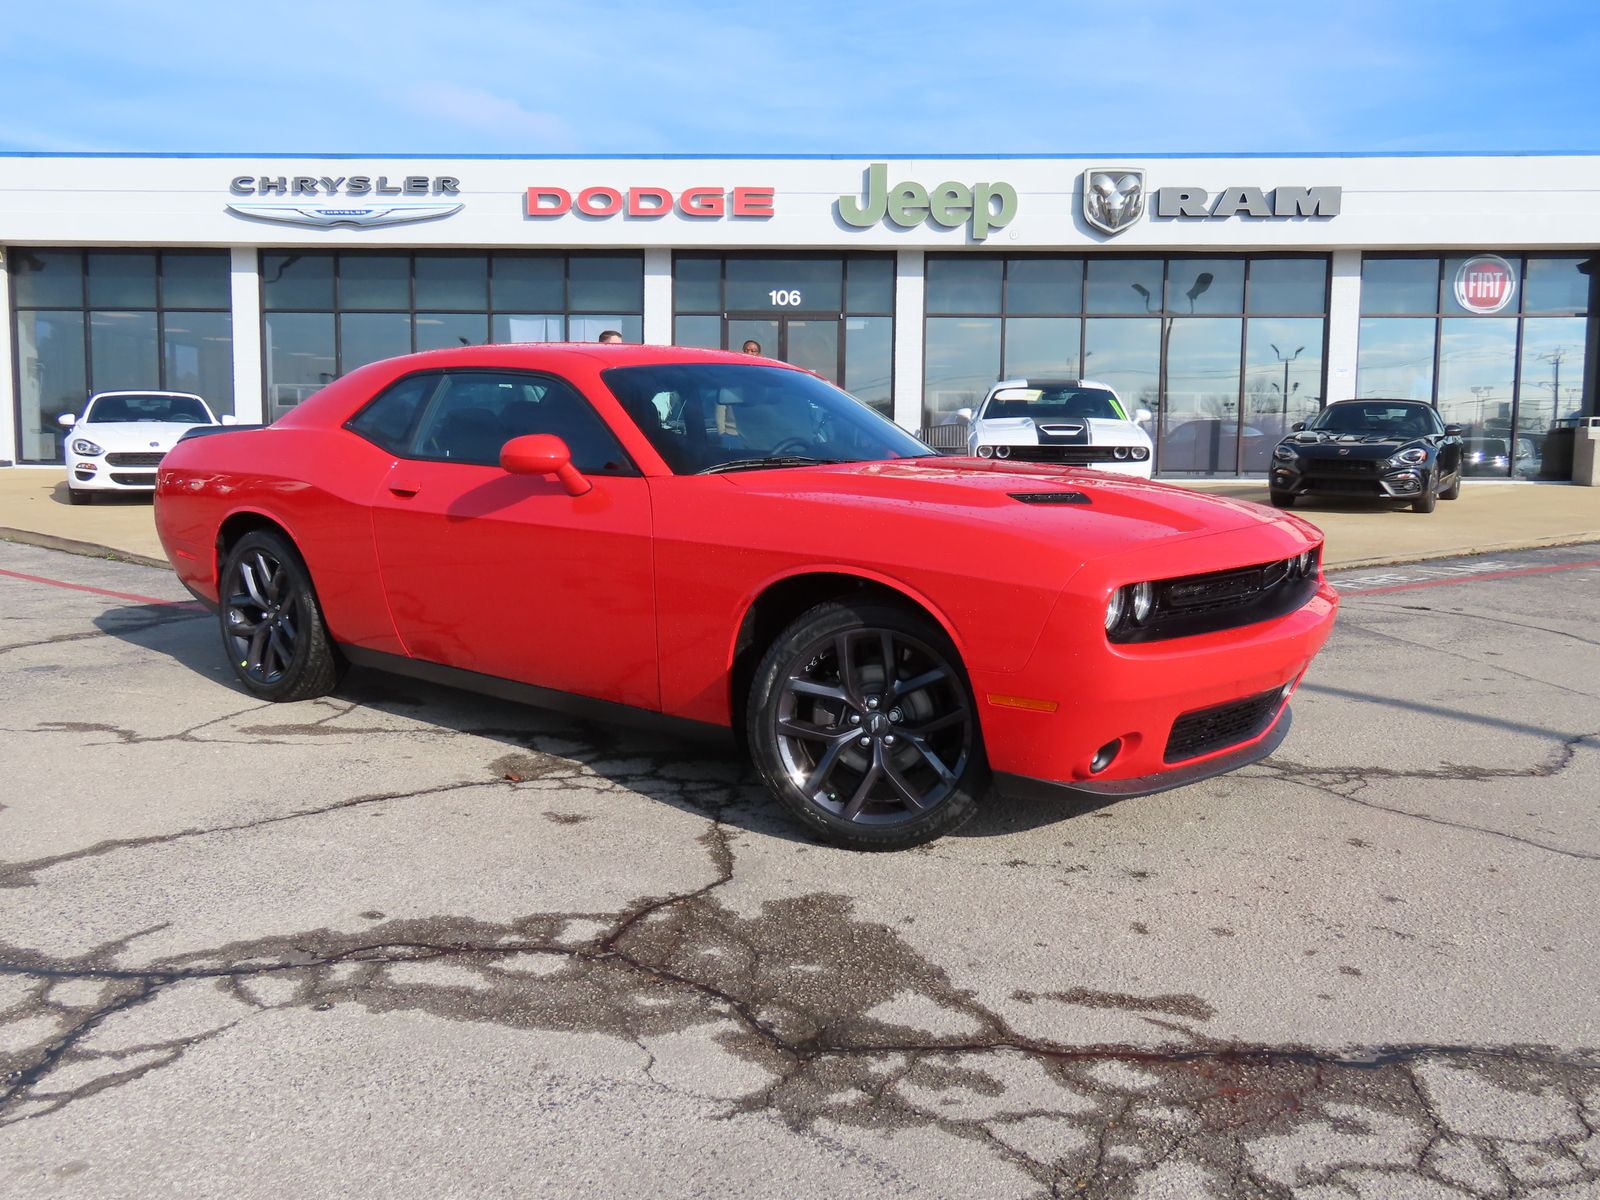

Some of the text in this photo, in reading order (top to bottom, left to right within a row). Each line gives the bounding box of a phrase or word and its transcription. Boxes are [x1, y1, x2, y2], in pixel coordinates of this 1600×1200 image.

[230, 175, 461, 195] CHRYSLER
[526, 186, 775, 216] DODGE
[838, 163, 1018, 240] Jeep
[1158, 186, 1342, 216] RAM
[768, 290, 801, 306] 106
[1468, 272, 1503, 298] FIAT
